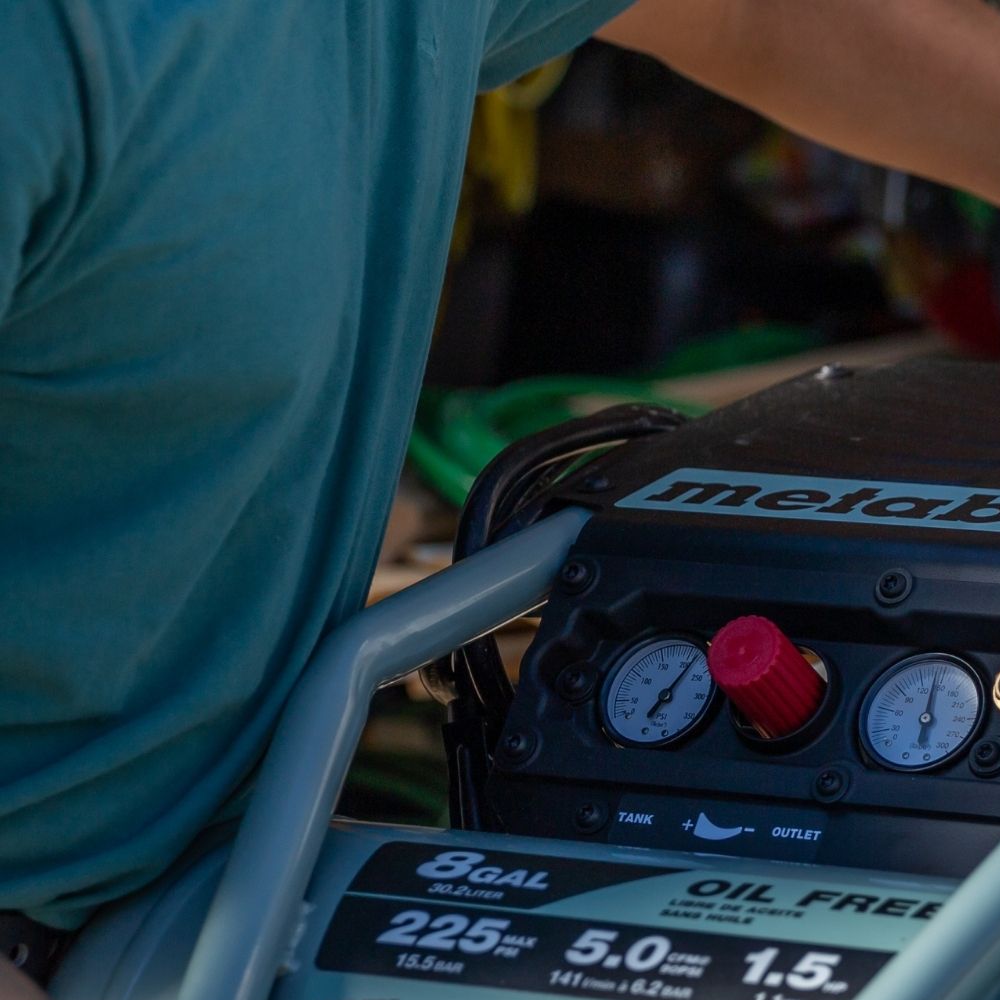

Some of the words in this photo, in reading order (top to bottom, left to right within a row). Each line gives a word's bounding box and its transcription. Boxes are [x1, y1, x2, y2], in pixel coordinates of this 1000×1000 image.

[658, 663, 669, 671] 150
[617, 811, 655, 825] TANK
[771, 826, 822, 841] OUTLET
[686, 879, 777, 903] OIL
[795, 889, 945, 920] FREE
[376, 909, 511, 955] 225
[501, 934, 538, 949] MAX
[565, 928, 672, 972] 5.0
[549, 969, 583, 988] 141
